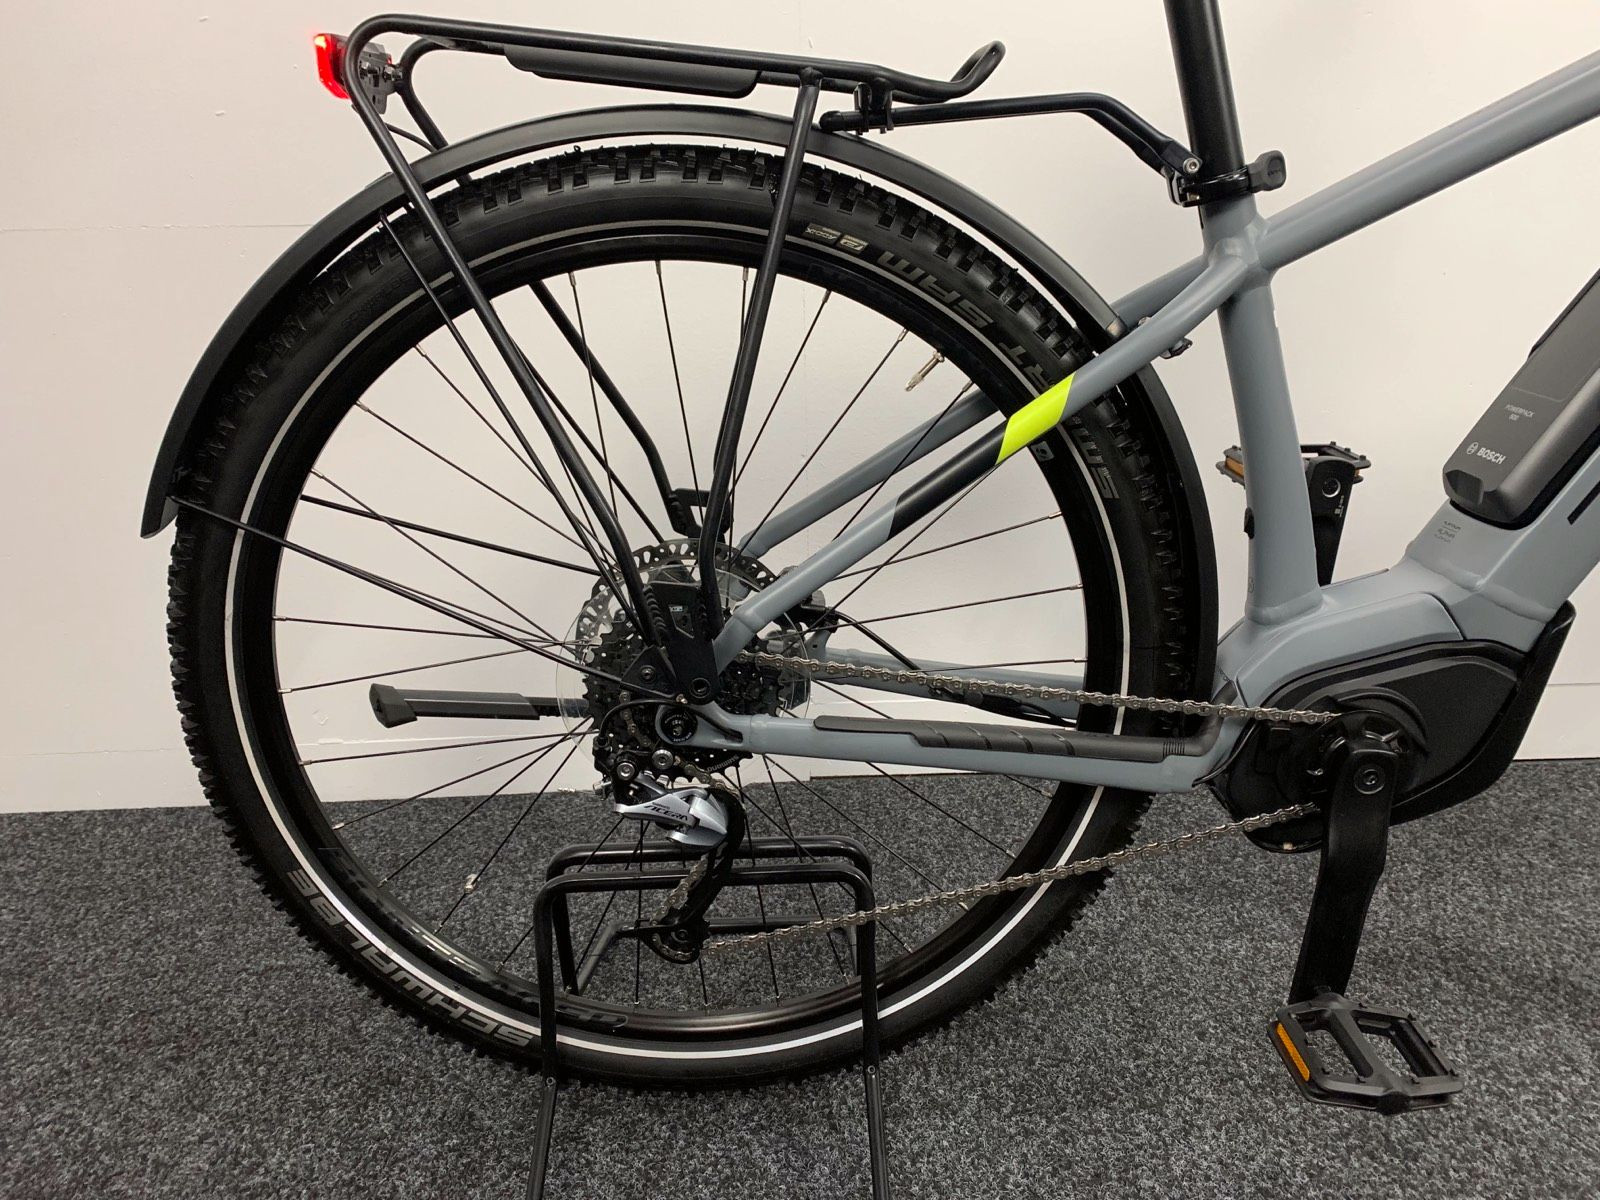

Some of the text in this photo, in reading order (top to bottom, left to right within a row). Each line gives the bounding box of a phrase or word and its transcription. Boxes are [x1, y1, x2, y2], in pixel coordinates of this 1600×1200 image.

[877, 252, 1119, 500] SMRT SAM
[1476, 447, 1507, 465] BOSCH
[286, 868, 534, 1048] SCHWALBE
